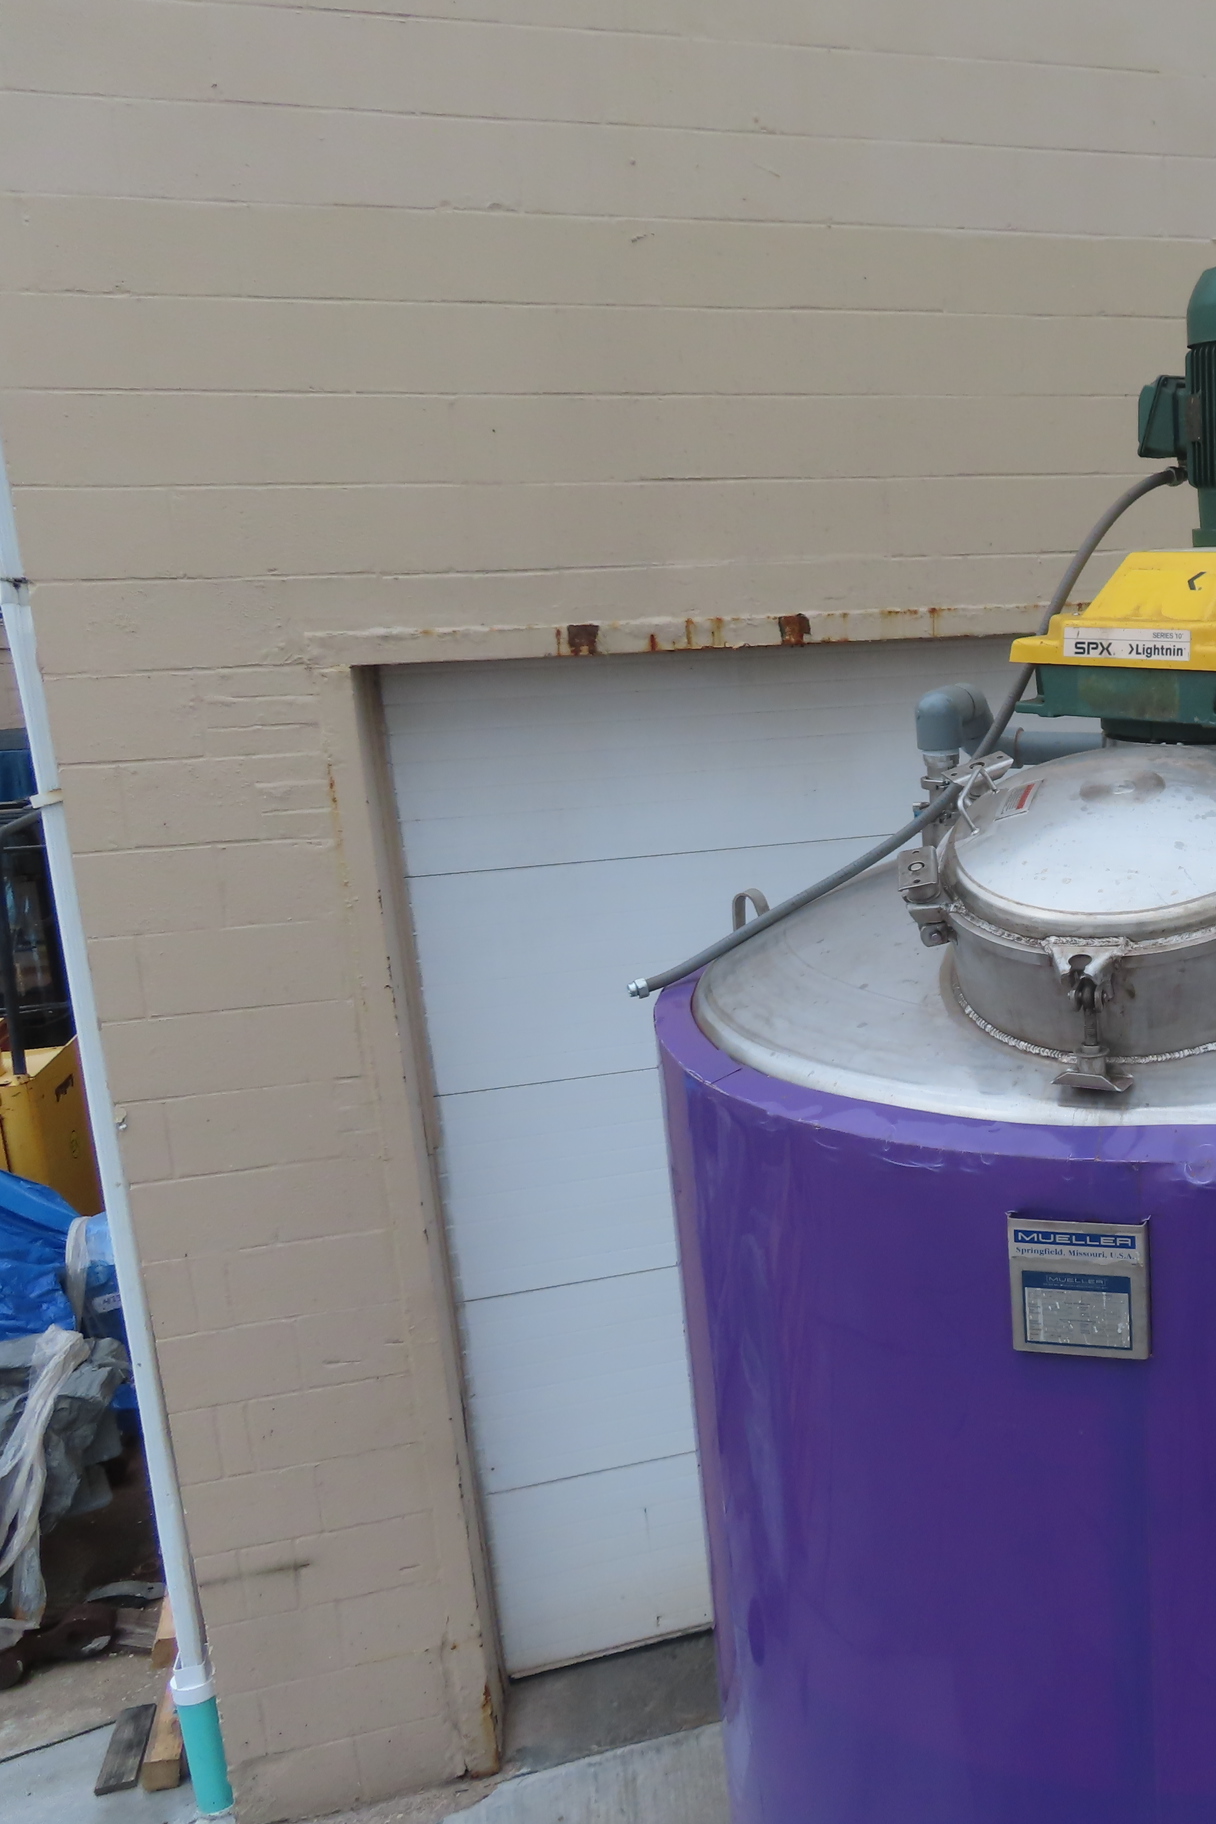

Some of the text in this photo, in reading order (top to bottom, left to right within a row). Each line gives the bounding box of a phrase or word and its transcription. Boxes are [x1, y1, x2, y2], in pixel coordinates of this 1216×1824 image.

[1074, 641, 1112, 656] SPX
[1018, 1232, 1132, 1247] MUELLER
[1015, 1246, 1135, 1260] Springfield, Missouri, U.S.A.
